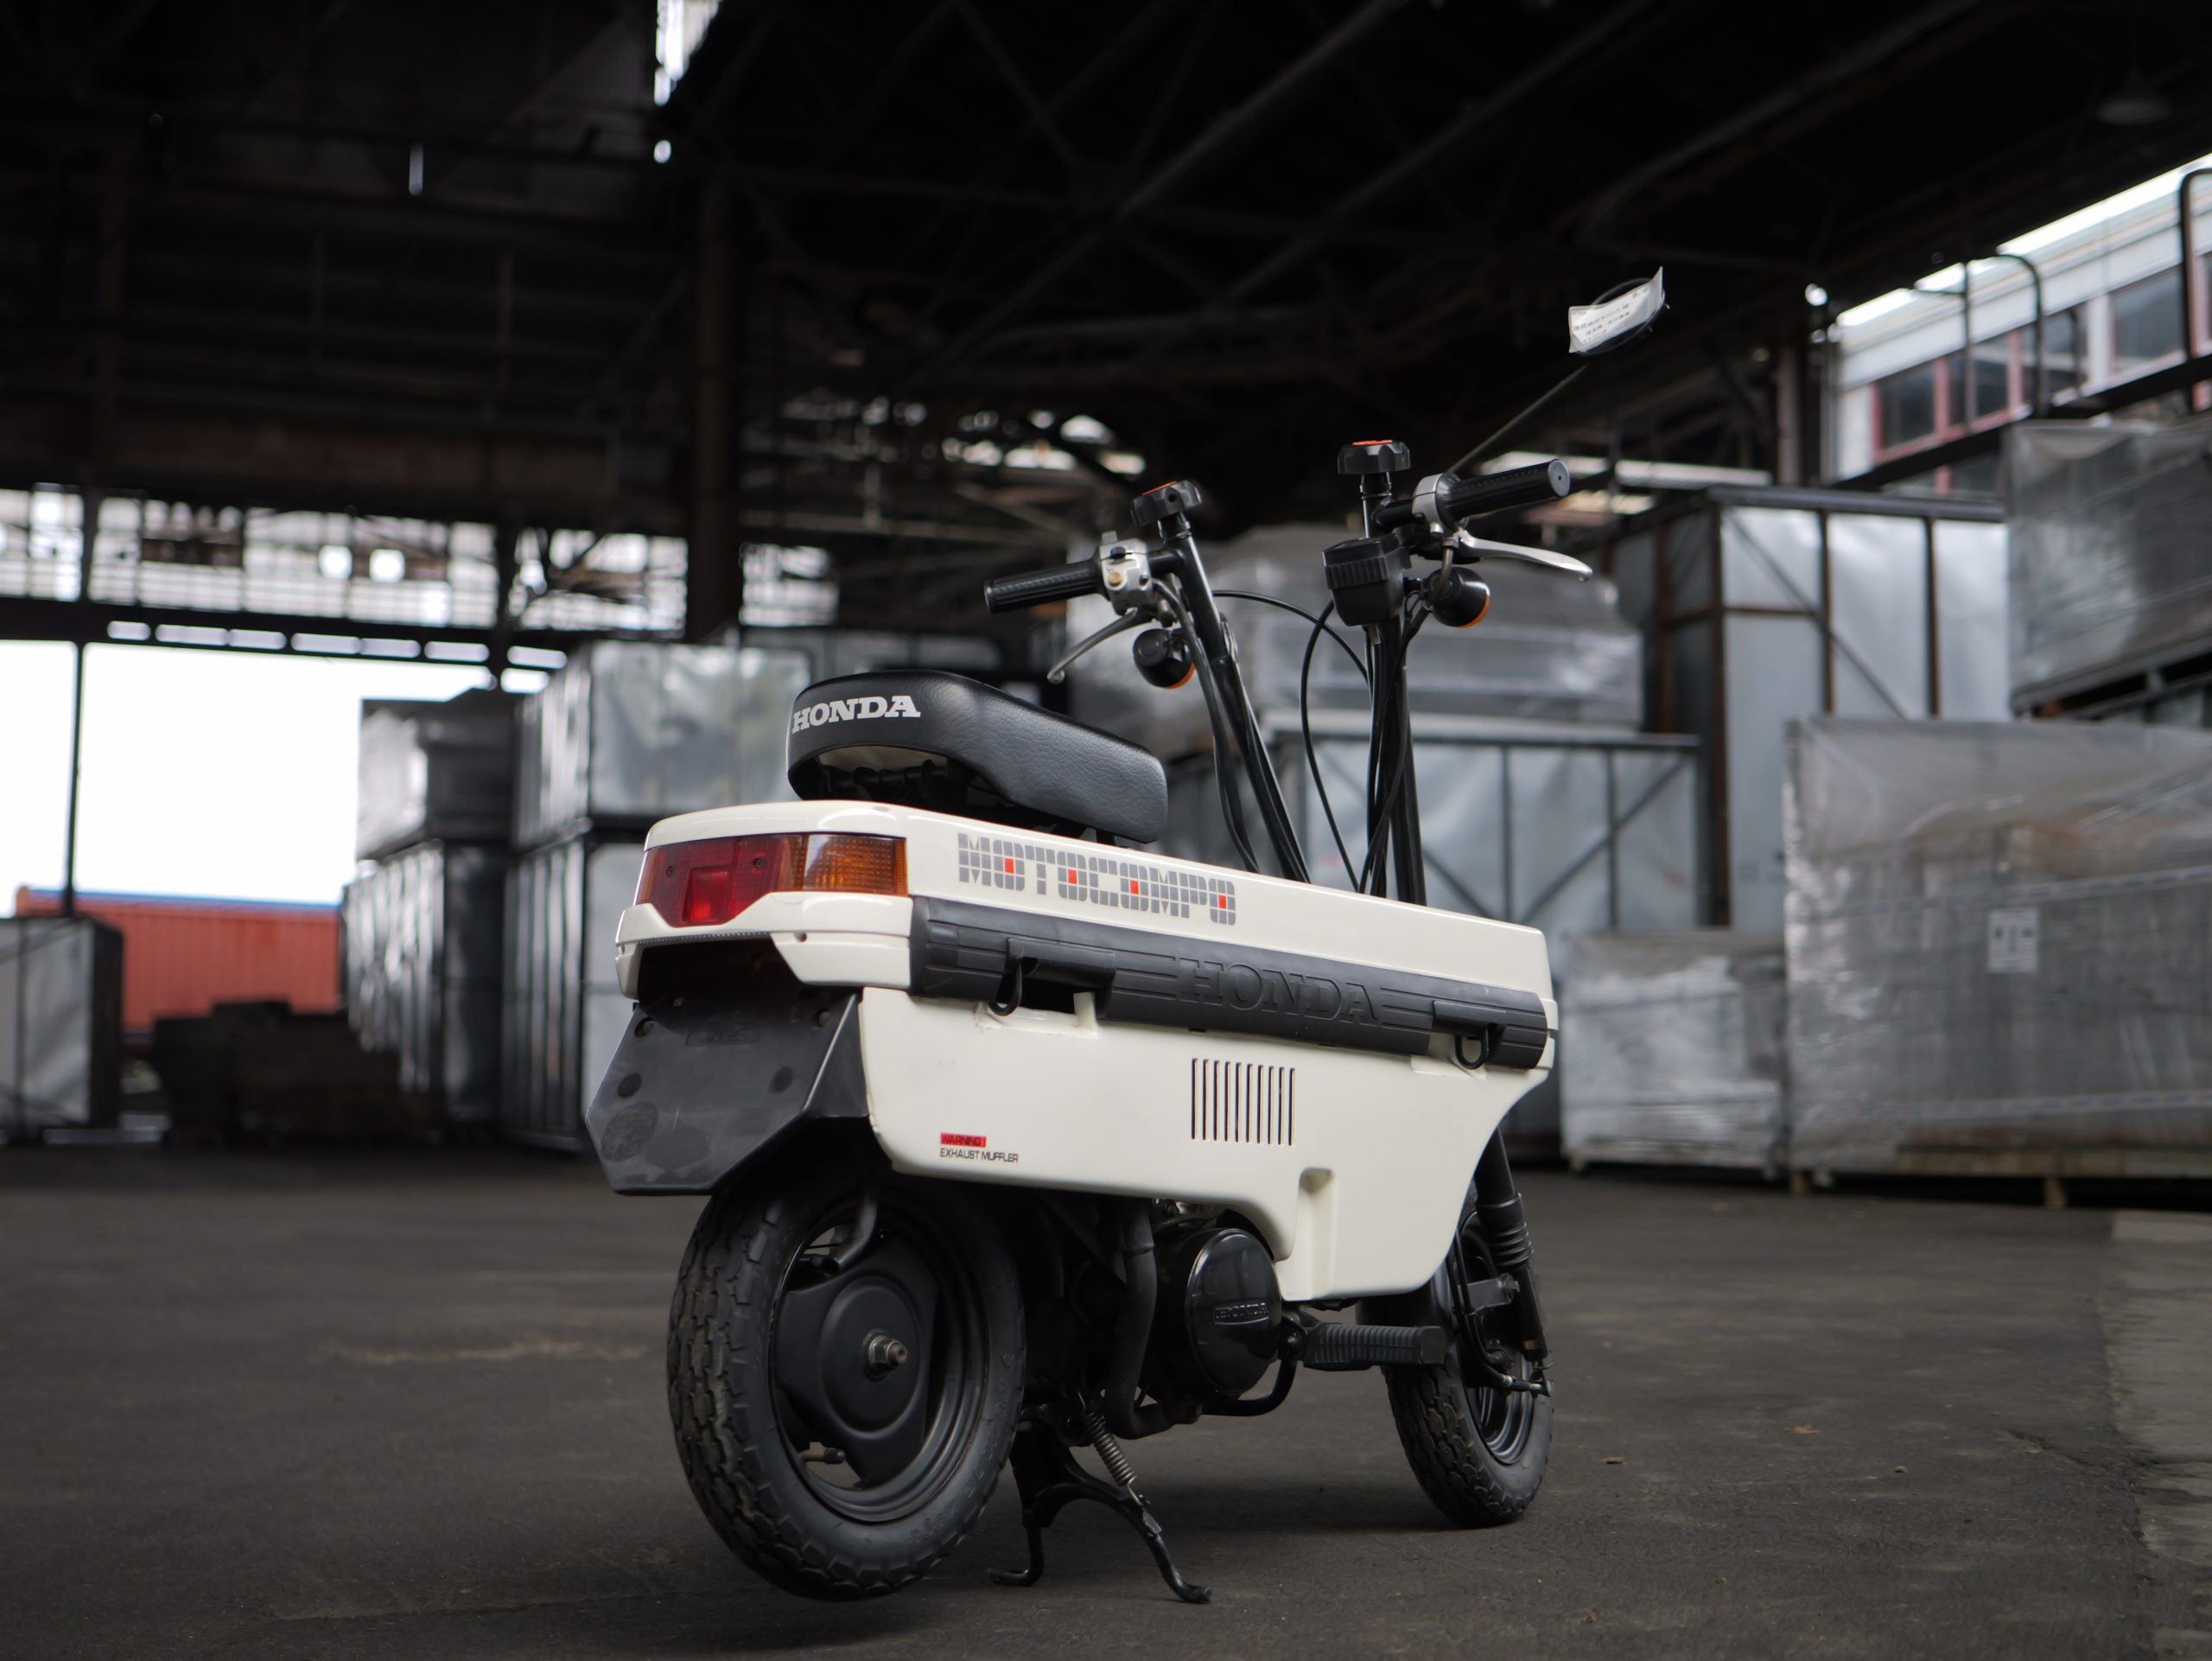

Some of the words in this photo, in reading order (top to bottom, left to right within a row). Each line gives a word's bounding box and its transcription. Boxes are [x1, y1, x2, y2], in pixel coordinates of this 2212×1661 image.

[791, 694, 921, 734] HONDA
[957, 832, 1236, 926] MOTOCOMPO
[1179, 958, 1379, 1027] HONDA
[940, 1148, 980, 1161] EXHAUST
[981, 1150, 1019, 1162] MUFFLER
[941, 1134, 982, 1147] WARNING
